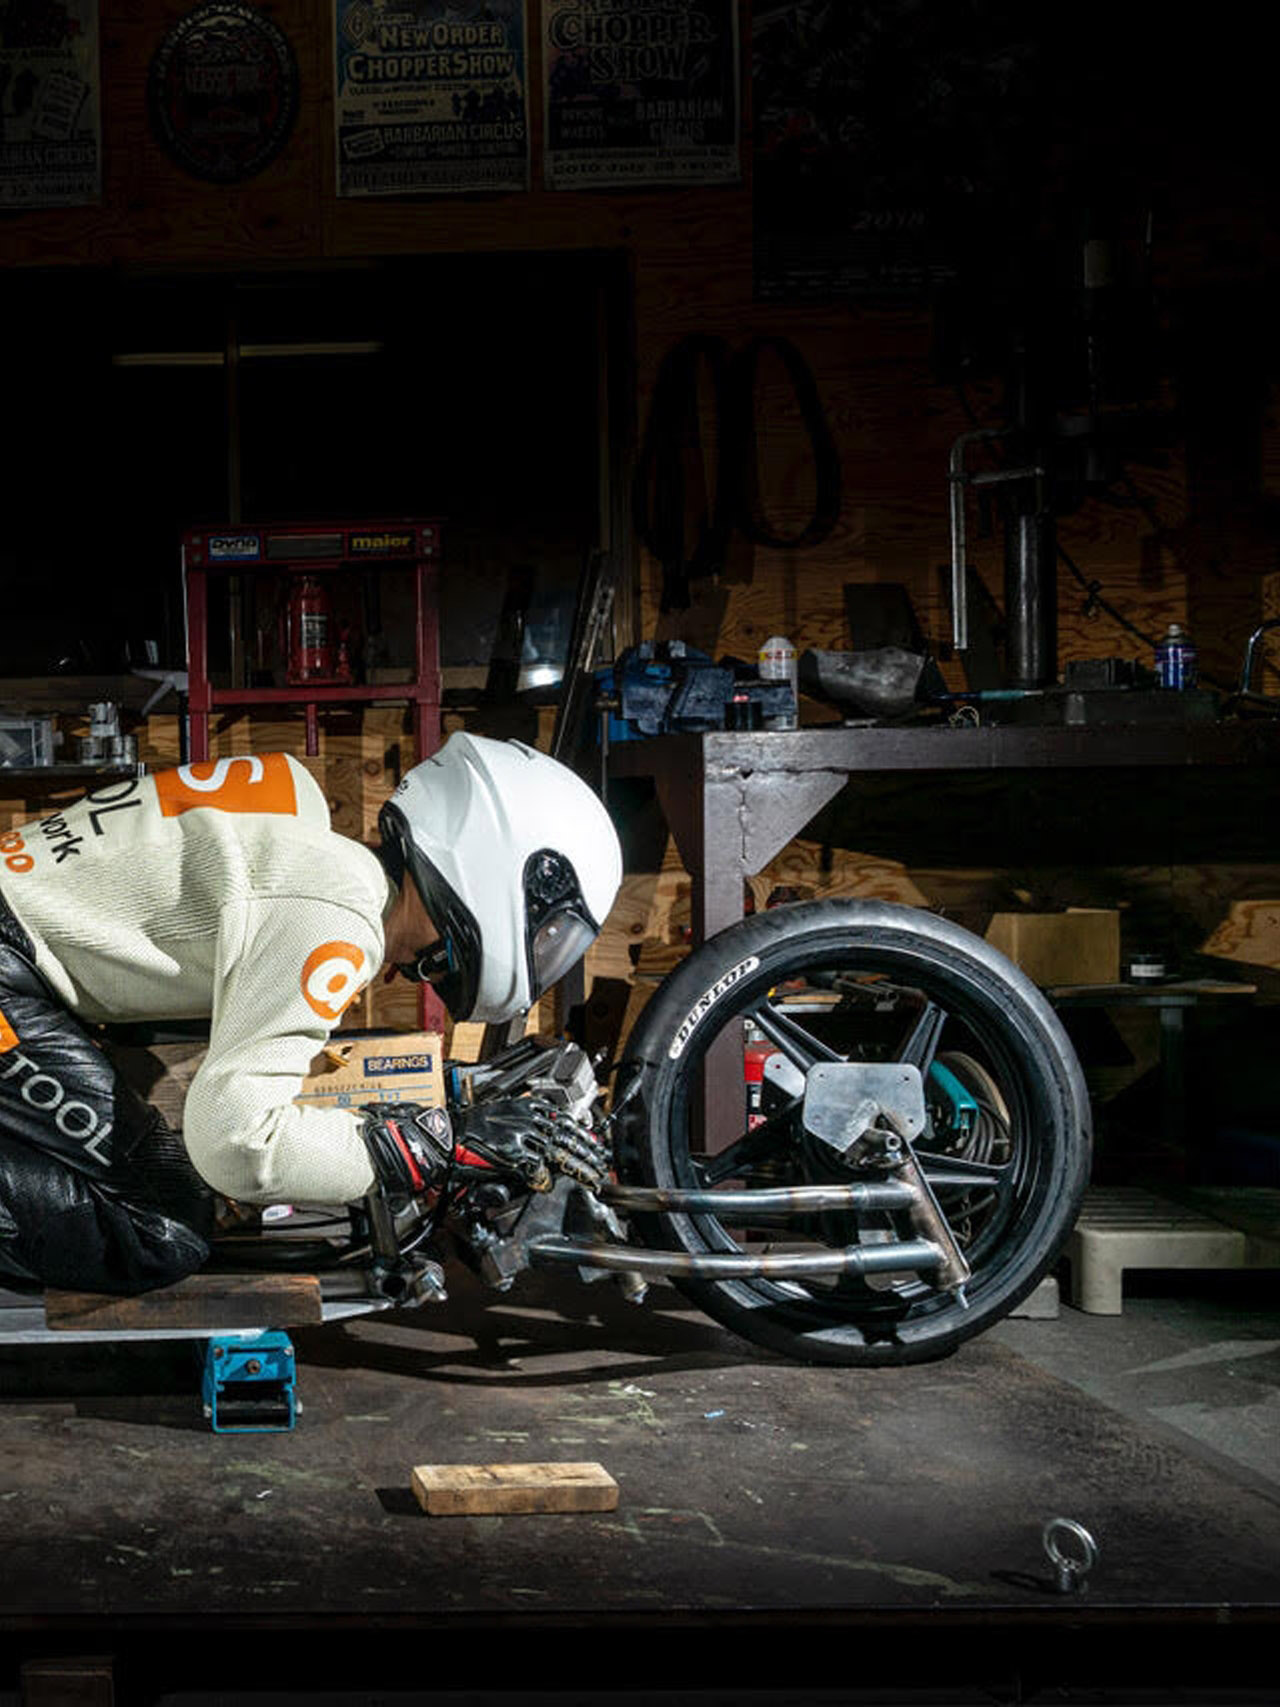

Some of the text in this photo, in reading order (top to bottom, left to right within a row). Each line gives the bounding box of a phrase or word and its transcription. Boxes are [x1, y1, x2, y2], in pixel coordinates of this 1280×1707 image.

[380, 22, 504, 48] NEW ORDER
[347, 51, 514, 79] CHOPPER SHOW
[678, 960, 753, 1043] DUNLOP
[367, 1055, 429, 1072] BEARINGS
[1, 1050, 113, 1167] TOOL
